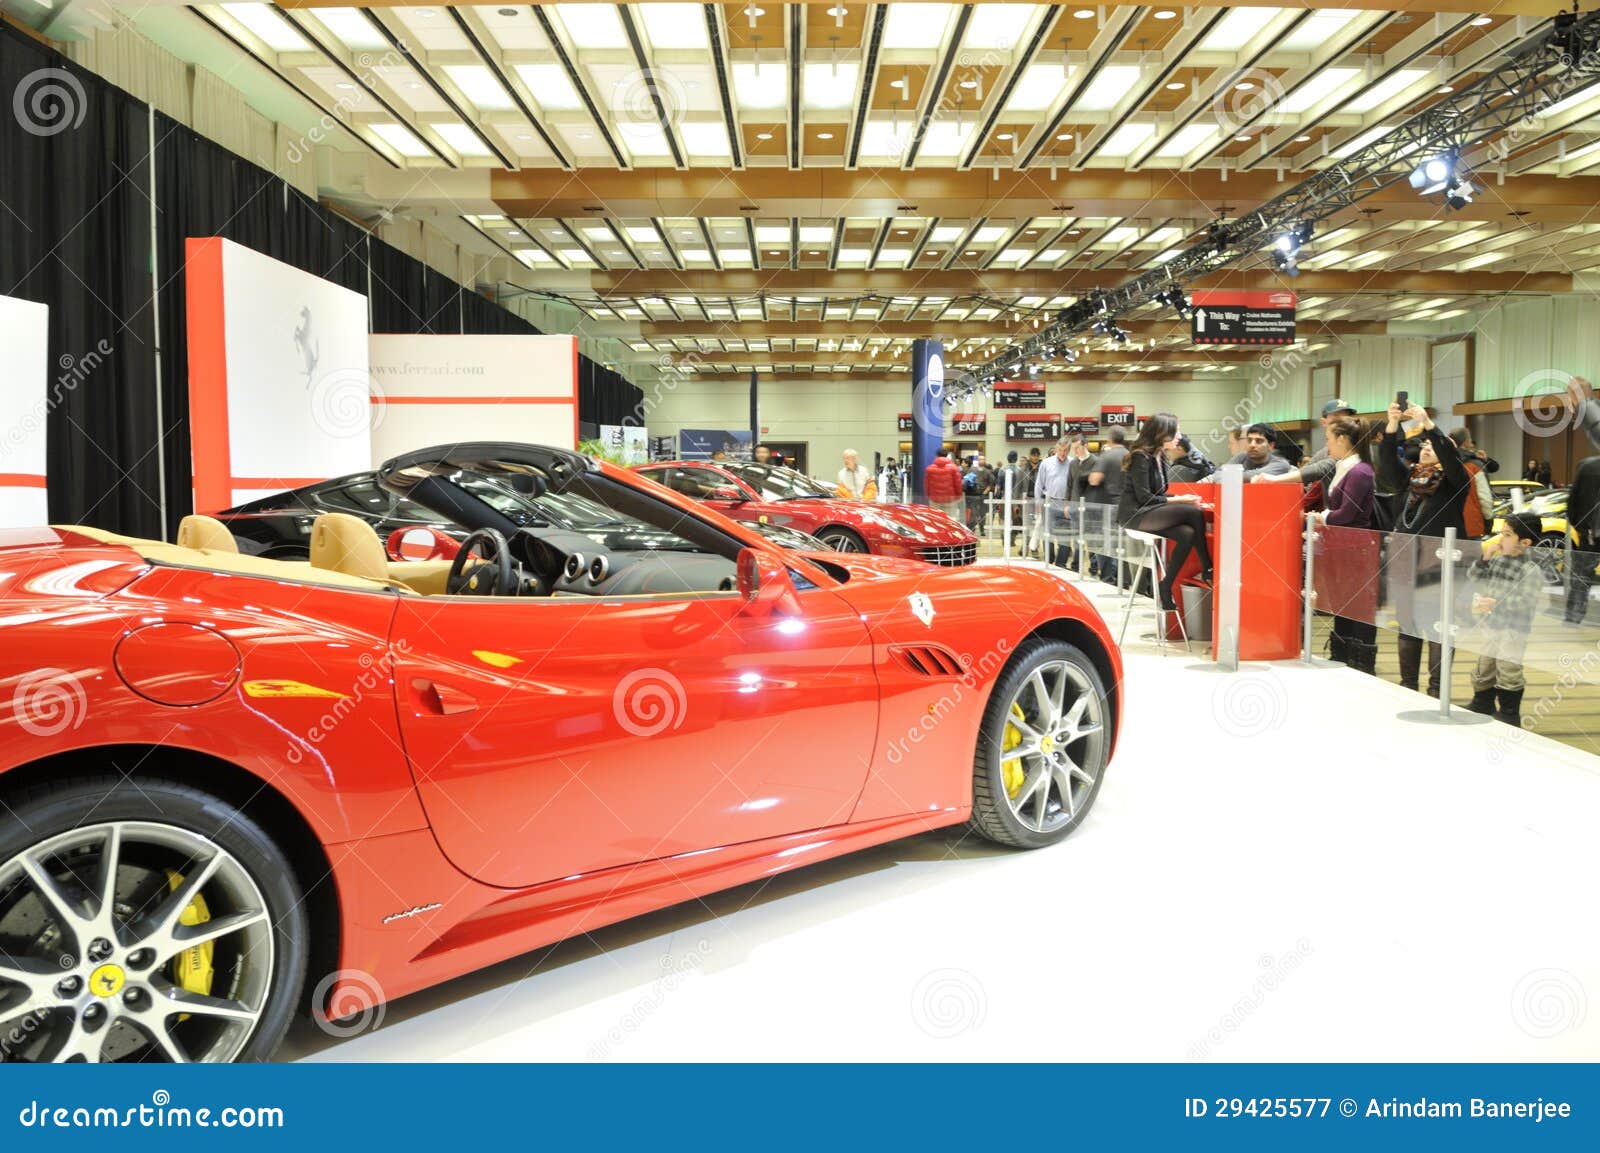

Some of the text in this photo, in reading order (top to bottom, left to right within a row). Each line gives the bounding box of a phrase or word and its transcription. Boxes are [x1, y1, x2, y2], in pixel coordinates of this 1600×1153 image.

[1209, 312, 1240, 321] This Way
[1107, 413, 1129, 423] EXIT
[959, 421, 980, 431] EXIT
